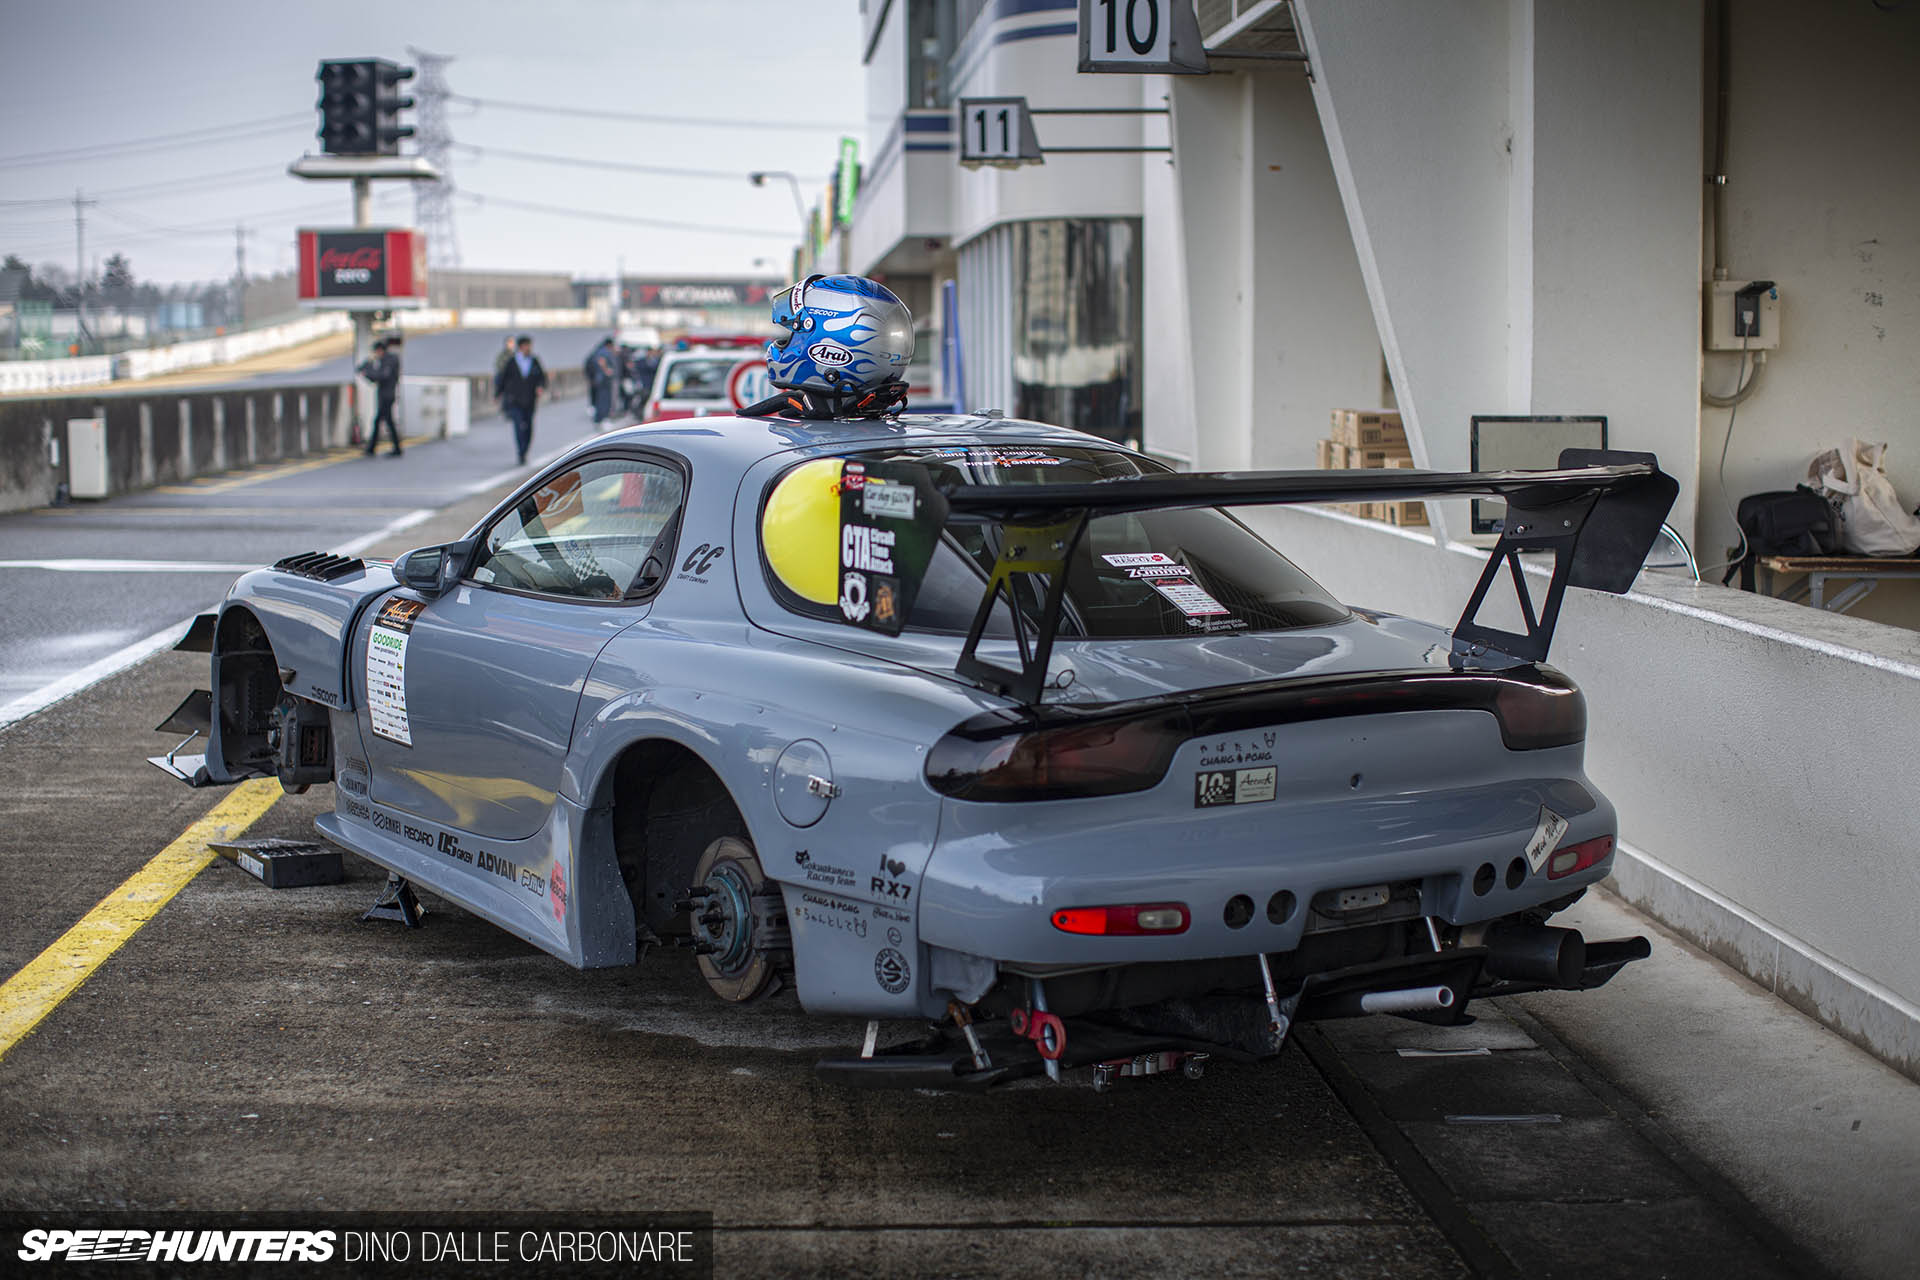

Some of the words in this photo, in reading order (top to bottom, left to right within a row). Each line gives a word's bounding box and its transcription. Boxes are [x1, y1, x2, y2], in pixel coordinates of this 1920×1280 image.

[1100, 0, 1159, 55] 10
[975, 109, 1009, 153] 11
[335, 268, 371, 284] zero
[658, 286, 738, 303] YOKOHAMA
[813, 309, 839, 318] SCOOT
[811, 347, 847, 362] Arai
[870, 528, 896, 546] Circuit
[842, 523, 872, 571] CTA
[871, 543, 890, 559] Time
[682, 543, 725, 576] CC
[373, 632, 403, 650] GOODRIDE
[317, 688, 338, 706] SCOOT
[1200, 755, 1235, 767] CHANG
[1245, 751, 1273, 762] PONG
[345, 777, 368, 795] QUANTUM
[385, 815, 402, 836] ENKEI
[404, 825, 434, 848] RECARO
[477, 850, 517, 882] ADVAN
[881, 854, 888, 871] I
[807, 871, 835, 886] Racing
[837, 875, 857, 888] Team
[870, 876, 912, 901] RX7
[802, 894, 829, 907] CHANG
[837, 903, 860, 915] PONG
